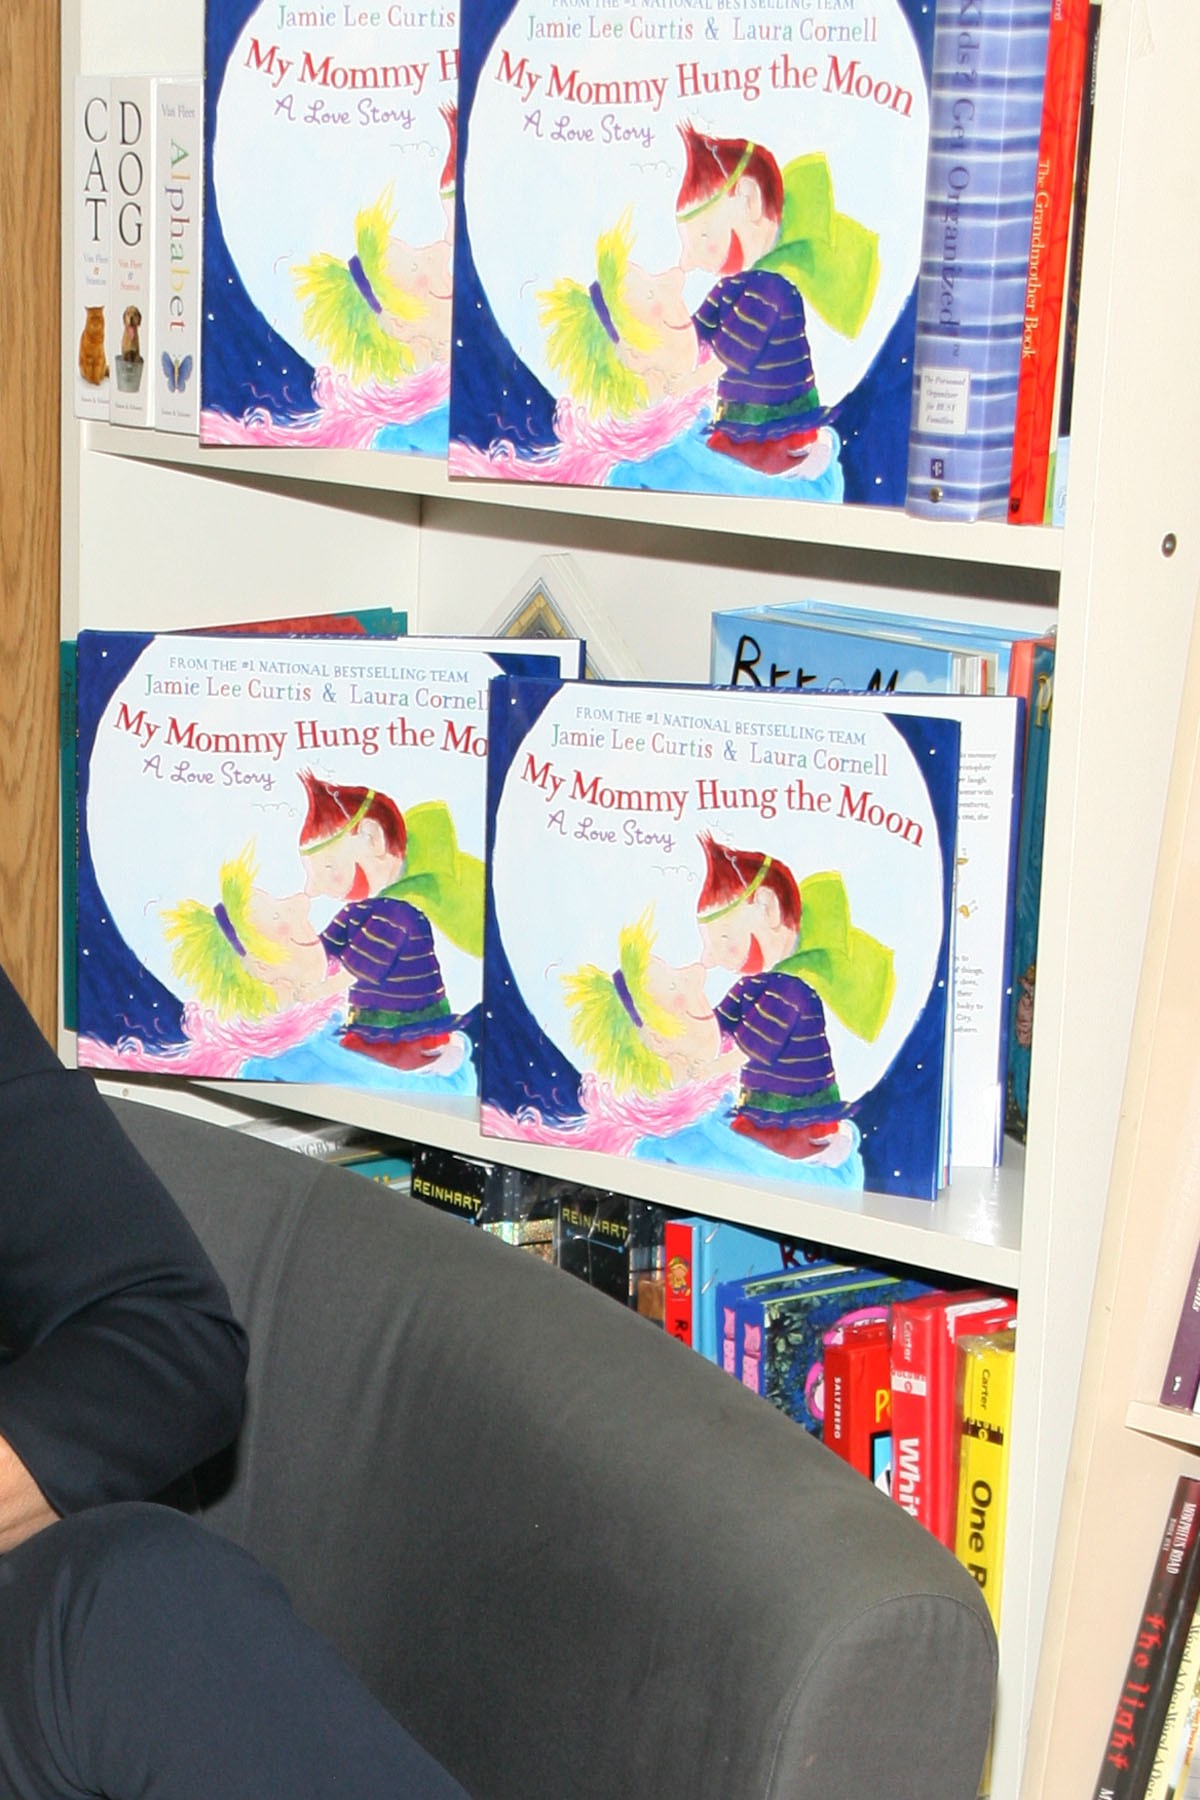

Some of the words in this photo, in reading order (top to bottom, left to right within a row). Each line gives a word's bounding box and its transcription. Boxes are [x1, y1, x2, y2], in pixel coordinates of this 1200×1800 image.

[277, 4, 337, 30] Jamie
[343, 5, 381, 27] Lee
[387, 5, 456, 28] Curtis
[527, 15, 582, 41] Jamie
[588, 15, 623, 39] Lee
[629, 15, 694, 40] Curtis
[704, 17, 720, 41] &
[732, 17, 793, 41] Laura
[799, 17, 878, 43] Cornell
[243, 37, 294, 89] My
[298, 51, 430, 96] Mommy
[494, 50, 542, 103] My
[543, 63, 669, 113] Mommy
[675, 59, 763, 101] Hung
[768, 53, 819, 90] the
[821, 54, 916, 118] Moon
[274, 94, 297, 122] A
[303, 99, 351, 126] Love
[357, 97, 417, 130] Story
[523, 109, 545, 138] A
[550, 117, 595, 143] Love
[600, 114, 656, 149] Story
[84, 97, 107, 242] CAT
[118, 101, 143, 246] DOG
[1035, 159, 1051, 188] The
[165, 138, 191, 331] Alphabet
[939, 166, 970, 328] Organized
[1025, 190, 1049, 312] Grandmother
[1021, 315, 1038, 359] Book
[144, 674, 200, 697] Jamie
[206, 676, 242, 698] Lee
[248, 679, 312, 701] Curtis
[322, 683, 337, 702] &
[350, 684, 409, 707] Laura
[169, 657, 208, 671] FROM
[212, 659, 237, 671] THE
[258, 661, 331, 678] NATIONAL
[334, 665, 426, 682] BESTSELLING
[429, 670, 469, 684] TEAM
[113, 702, 161, 747] My
[163, 716, 289, 761] Mommy
[294, 720, 380, 755] Hung
[386, 716, 435, 747] the
[440, 719, 488, 758] Mo
[575, 706, 615, 722] FROM
[617, 710, 643, 724] THE
[662, 714, 731, 734] NATIONAL
[735, 722, 825, 742] BESTSELLING
[828, 731, 866, 746] TEAM
[551, 724, 605, 748] Jamie
[611, 728, 646, 751] Lee
[651, 733, 714, 759] Curtis
[723, 740, 738, 762] &
[749, 743, 807, 769] Laura
[813, 752, 889, 777] Cornell
[142, 754, 164, 779] A
[170, 760, 214, 785] Love
[221, 761, 276, 791] Story
[520, 753, 566, 803] My
[568, 770, 689, 821] Mommy
[695, 779, 778, 819] Hung
[784, 779, 832, 812] the
[836, 784, 925, 848] Moon
[546, 810, 568, 836] A
[574, 817, 618, 845] Love
[623, 819, 677, 852] Story
[413, 1177, 481, 1210] REINHART
[562, 1206, 629, 1240] REINHART
[903, 1320, 913, 1362] Carter
[981, 1368, 991, 1410] Carter
[968, 1479, 993, 1553] One
